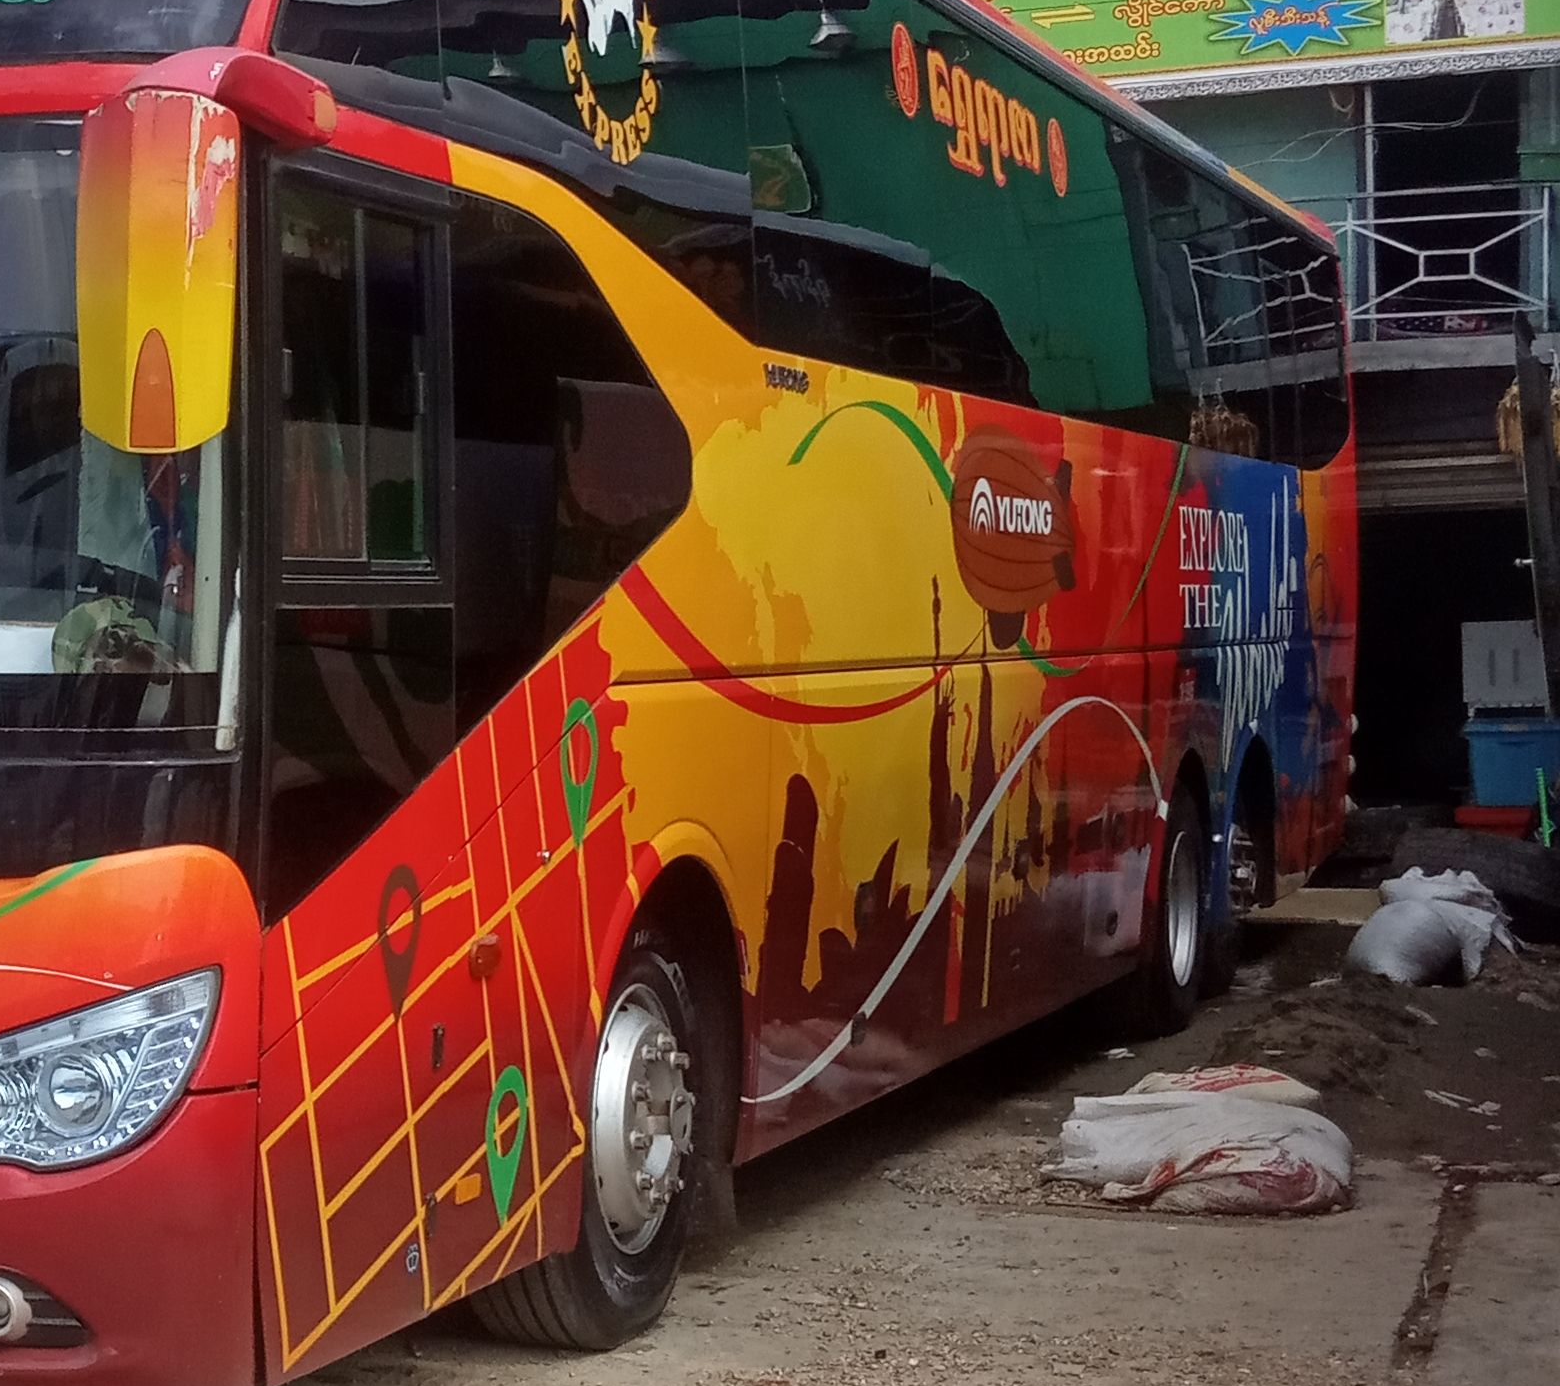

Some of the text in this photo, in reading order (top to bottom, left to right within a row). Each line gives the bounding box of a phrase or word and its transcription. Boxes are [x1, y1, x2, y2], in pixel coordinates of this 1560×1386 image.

[561, 31, 660, 165] EXPRESS
[996, 495, 1053, 535] YUTONG
[1179, 505, 1244, 571] EXPLORE
[1179, 584, 1222, 630] THE
